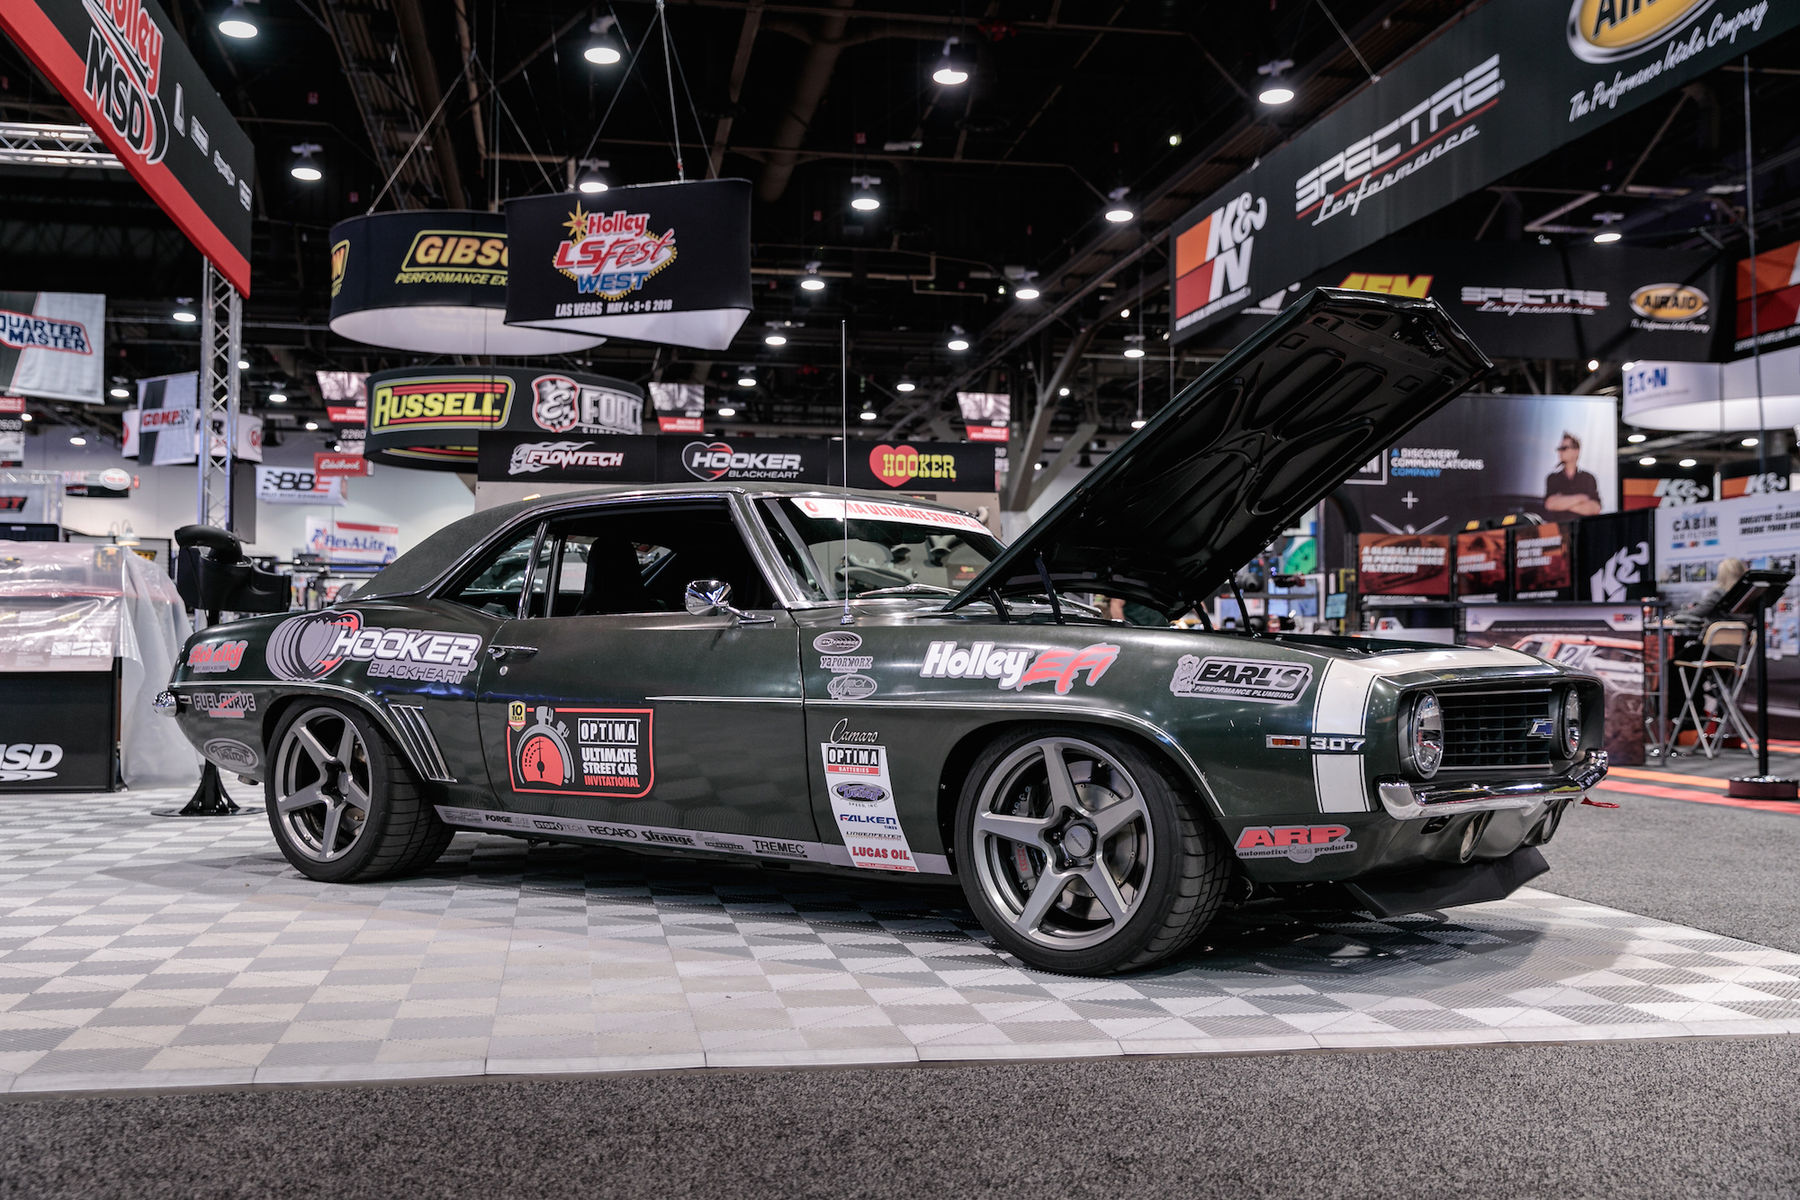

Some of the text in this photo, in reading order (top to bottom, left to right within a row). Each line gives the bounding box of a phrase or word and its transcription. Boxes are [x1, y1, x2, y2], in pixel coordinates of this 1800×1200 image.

[103, 0, 163, 98] olley
[1590, 71, 1663, 110] Performance
[1706, 0, 1769, 48] Company
[84, 27, 147, 154] MSD
[1296, 53, 1500, 212] SPECTRE
[1312, 124, 1480, 227] Performance
[588, 212, 647, 237] Holley
[415, 236, 508, 265] GIBS
[1205, 191, 1267, 303] K&N
[395, 273, 488, 285] PERFORMANCE
[578, 272, 649, 293] WEST
[1461, 286, 1608, 306] SPECTRE
[555, 304, 573, 317] LAS
[573, 302, 603, 316] VEGAS
[606, 303, 623, 314] MAY
[9, 329, 87, 352] MASTER
[373, 387, 500, 428] RUSSELL
[527, 451, 624, 470] FLOWTECH
[692, 452, 801, 471] HOOKER
[1401, 448, 1459, 459] DISCOVERY
[882, 453, 957, 479] HOOKER
[1391, 457, 1484, 470] COMMUNICATIONS
[1391, 468, 1441, 477] COMPANY
[728, 470, 799, 479] BLACKHEART
[866, 503, 931, 522] ULTIMATE
[1673, 516, 1718, 532] CABIN
[329, 630, 478, 667] HOOKER
[368, 663, 467, 685] BLACKHEART
[922, 643, 1117, 693] Holley EFI
[1197, 663, 1303, 688] EARL'S
[1194, 685, 1295, 699] PERFORMANCE PLUMBING
[511, 704, 523, 717] 10
[580, 722, 636, 742] OPTIMA
[830, 718, 878, 744] Camaro
[1310, 736, 1367, 751] 307
[581, 747, 637, 763] ULTIMATE
[828, 748, 878, 765] OPTIMA
[582, 762, 639, 776] STREET CAR
[838, 766, 870, 774] BATTERIES
[584, 775, 641, 788] INVITATIONAL
[840, 814, 897, 826] FALKEN
[587, 825, 637, 839] RECARO
[640, 830, 695, 846] Strange
[1238, 827, 1347, 848] ARP
[752, 839, 805, 855] TREMEC
[852, 846, 910, 861] LUCAS OIL
[1238, 848, 1288, 857] automotive
[1314, 842, 1355, 854] products
